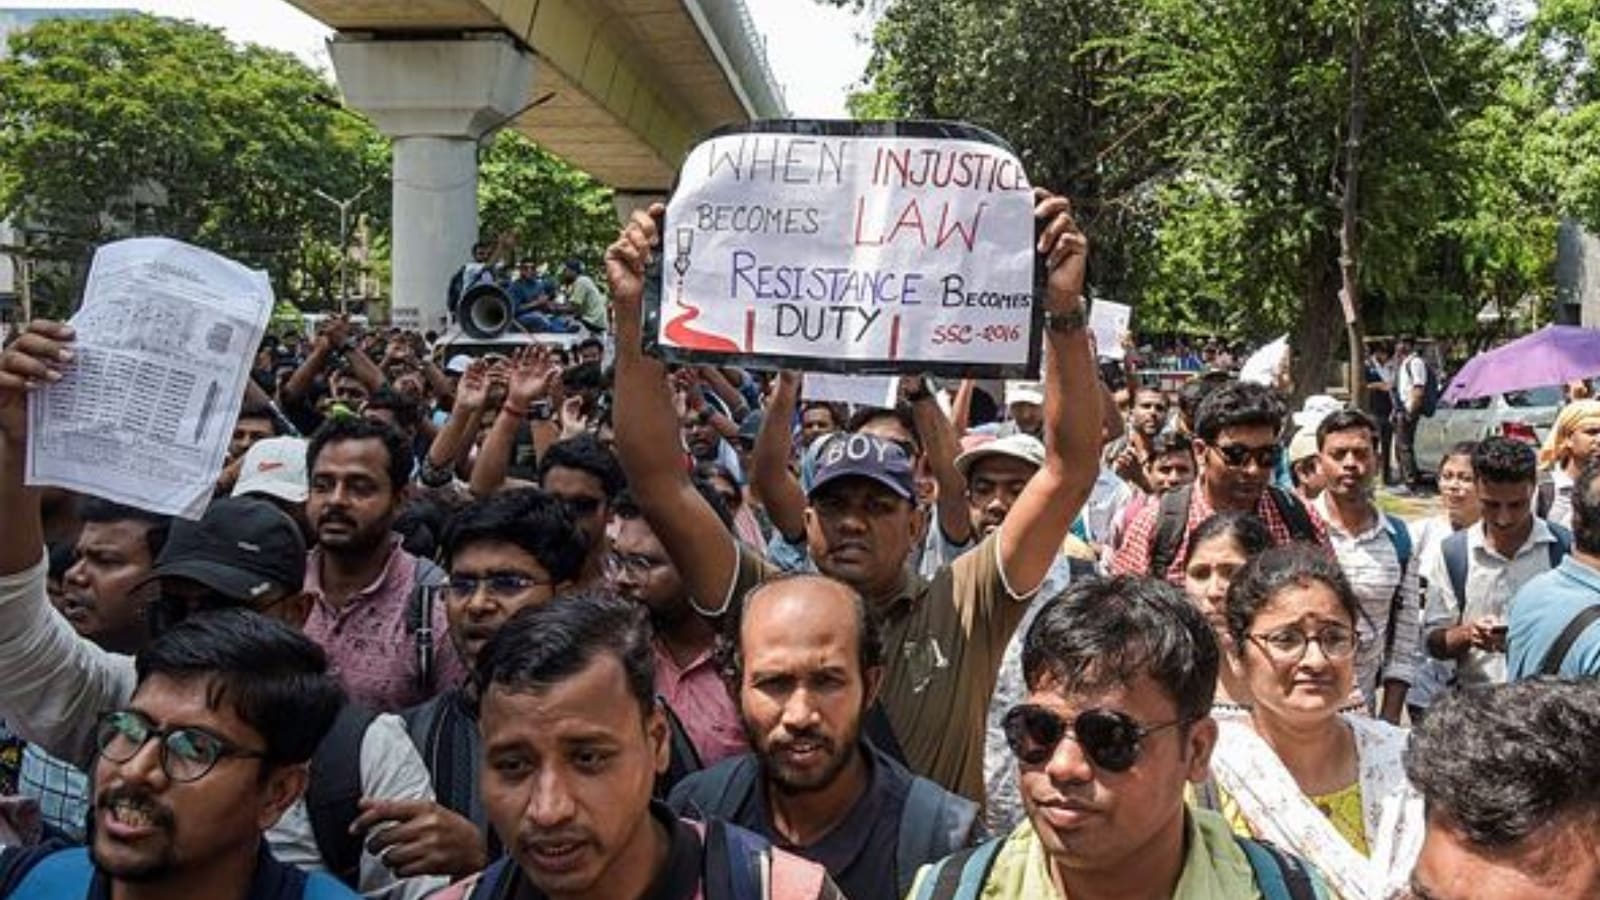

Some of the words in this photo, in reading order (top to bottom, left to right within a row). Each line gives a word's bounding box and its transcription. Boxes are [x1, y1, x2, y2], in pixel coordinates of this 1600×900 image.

[708, 138, 847, 185] WHEN
[871, 146, 1029, 191] INJUSTICE
[696, 204, 820, 235] BECOMES
[854, 195, 989, 253] LAW
[731, 251, 923, 304] RESISTANCE
[940, 273, 1032, 310] BECOMES
[773, 304, 881, 342] DUTY
[827, 434, 889, 465] BOY
